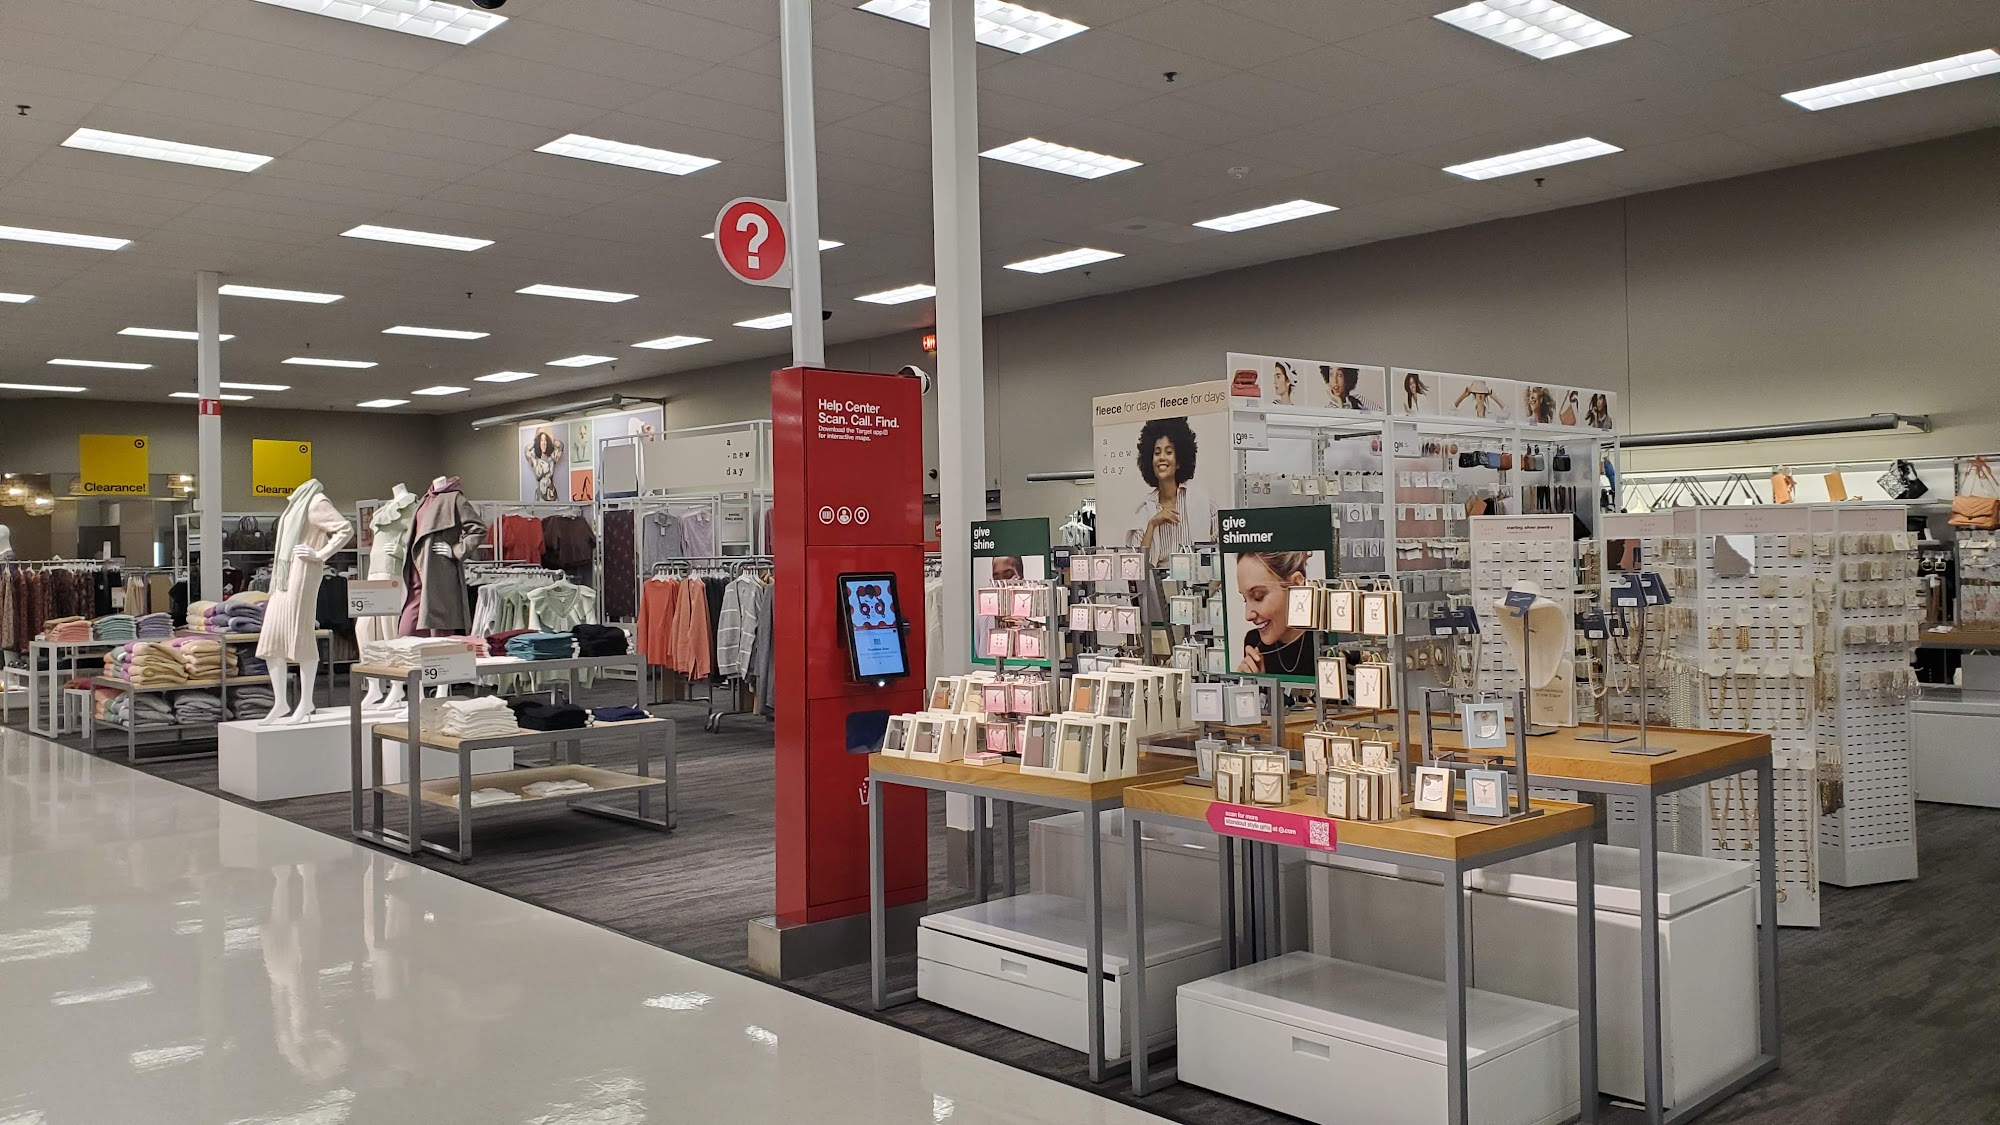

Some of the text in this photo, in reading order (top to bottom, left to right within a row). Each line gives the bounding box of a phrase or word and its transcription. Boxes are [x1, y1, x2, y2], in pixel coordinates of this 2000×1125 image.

[736, 213, 769, 269] ?
[818, 398, 880, 414] Help Center
[1095, 391, 1226, 416] fleece for days fleece for days
[818, 412, 900, 428] Scan. Call. Find.
[818, 425, 845, 433] Download
[855, 427, 873, 436] Target
[726, 467, 744, 477] day
[1102, 465, 1125, 475] day
[84, 482, 146, 492] Clearance!
[255, 484, 296, 494] Clearan
[1222, 515, 1246, 531] give
[973, 526, 991, 539] give
[1223, 531, 1273, 544] shimmer
[973, 539, 995, 550] shine
[1225, 818, 1246, 827] standout
[1247, 821, 1259, 829] style
